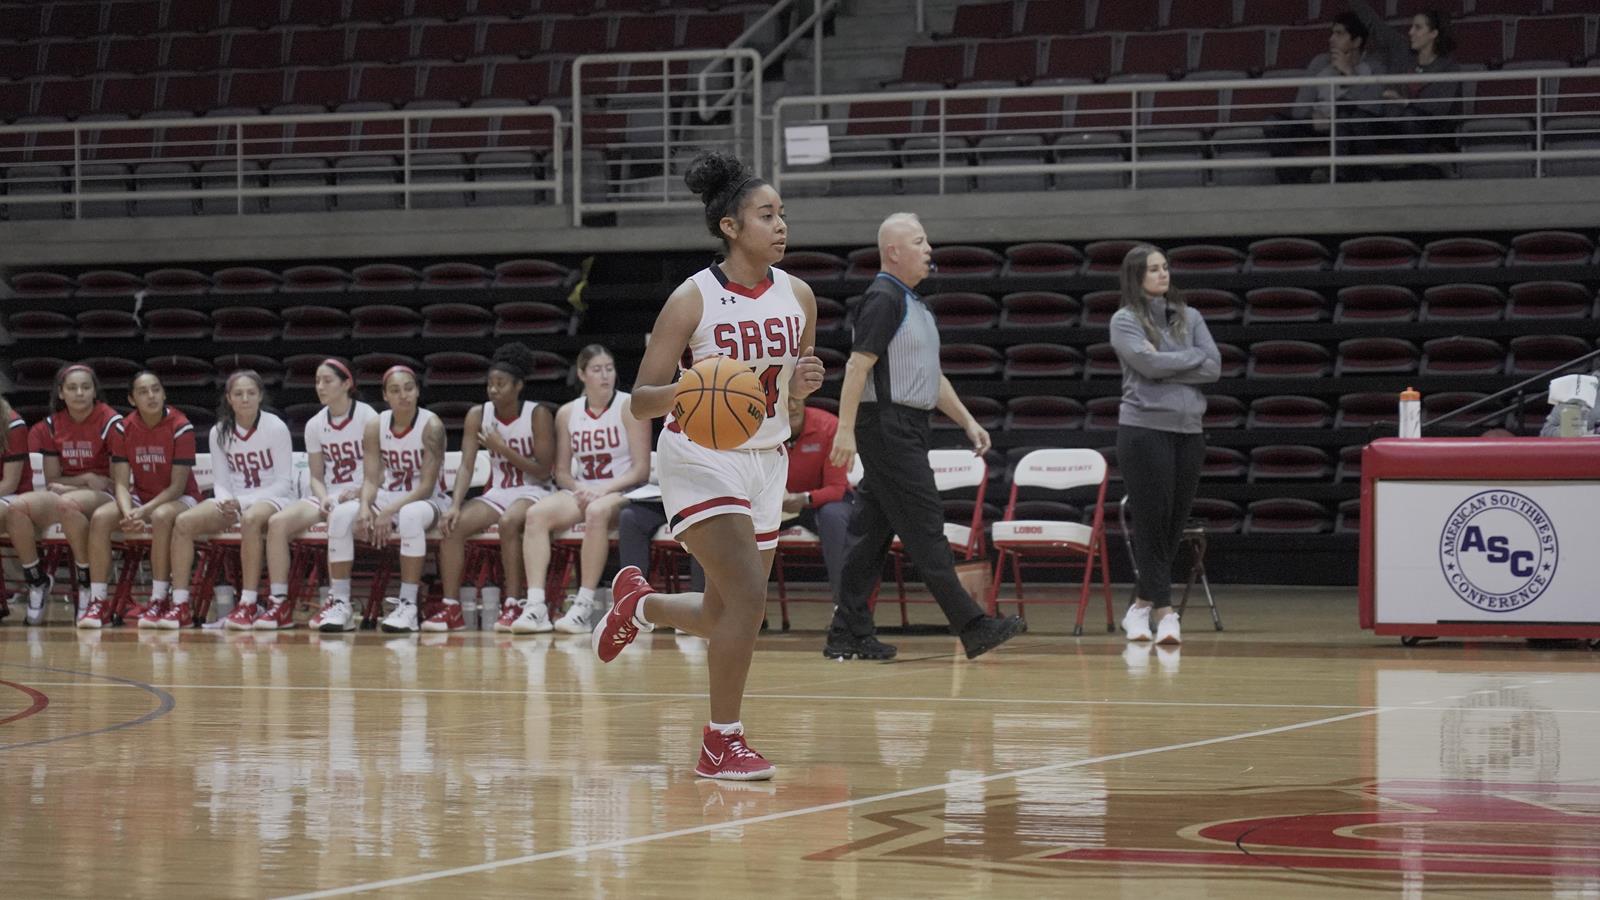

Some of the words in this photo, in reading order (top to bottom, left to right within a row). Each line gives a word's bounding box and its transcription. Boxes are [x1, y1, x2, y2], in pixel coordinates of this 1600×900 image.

[714, 316, 801, 361] SRSU
[749, 364, 784, 419] 4
[571, 426, 620, 453] SRSU
[331, 458, 357, 484] 12
[580, 453, 614, 480] 32
[1444, 497, 1487, 557] AMERICAN
[1490, 494, 1555, 554] SOUTHWEST
[1460, 525, 1534, 577] ASC
[1451, 573, 1546, 609] CONFERENCE
